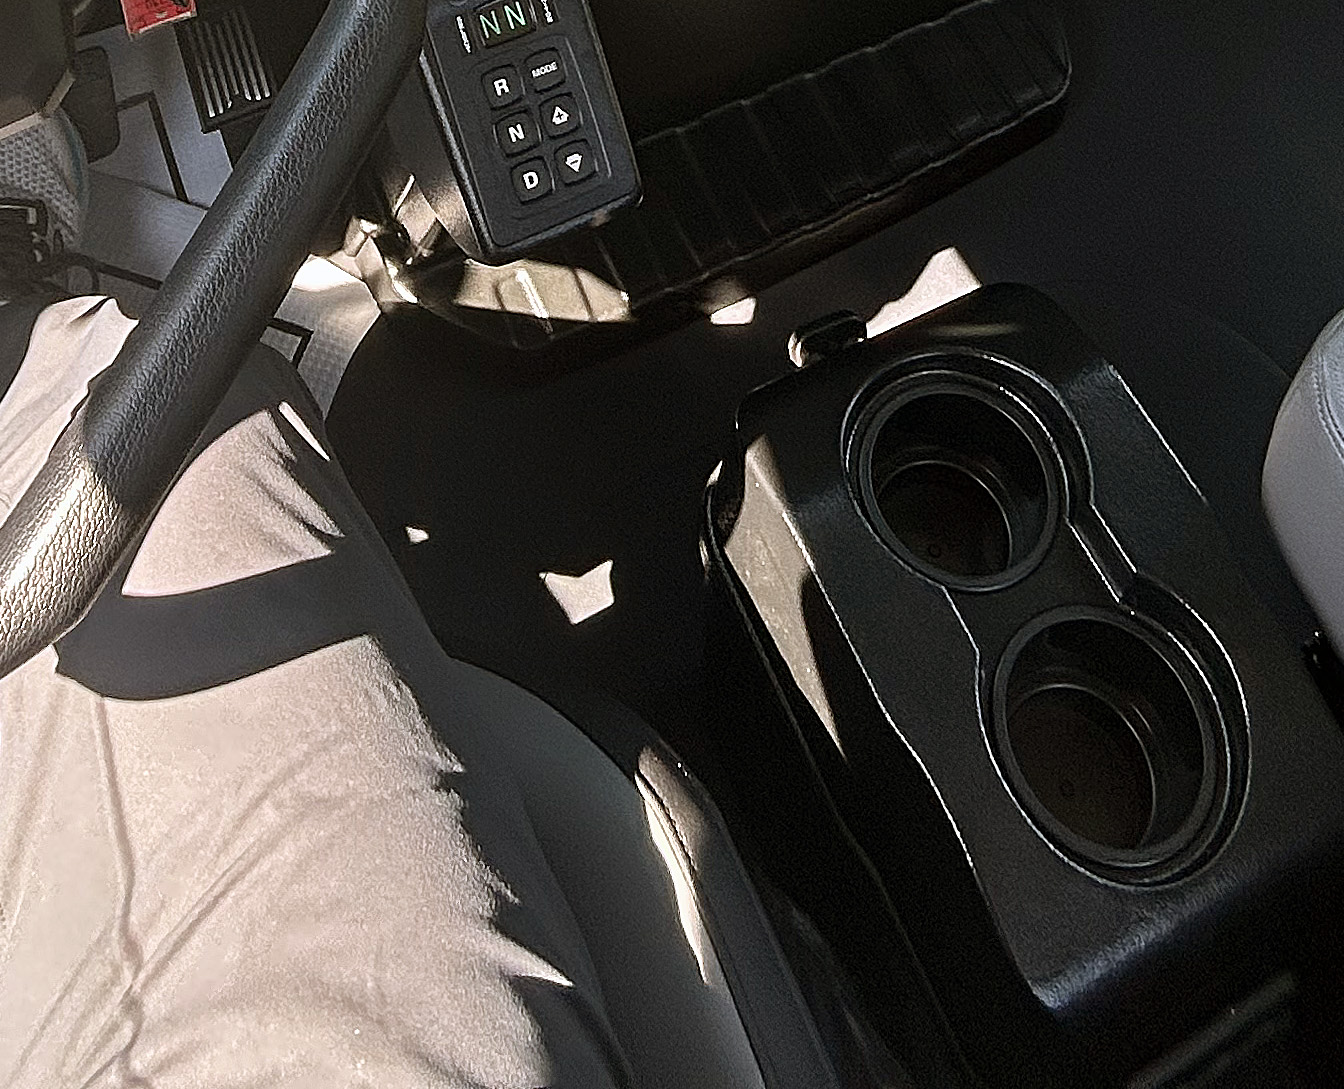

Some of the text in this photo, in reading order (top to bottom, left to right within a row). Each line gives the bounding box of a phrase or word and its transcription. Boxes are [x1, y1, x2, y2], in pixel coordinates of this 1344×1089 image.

[479, 1, 526, 38] N N
[532, 61, 557, 78] MODE
[493, 78, 509, 96] R
[508, 124, 525, 142] N
[523, 171, 538, 190] D
